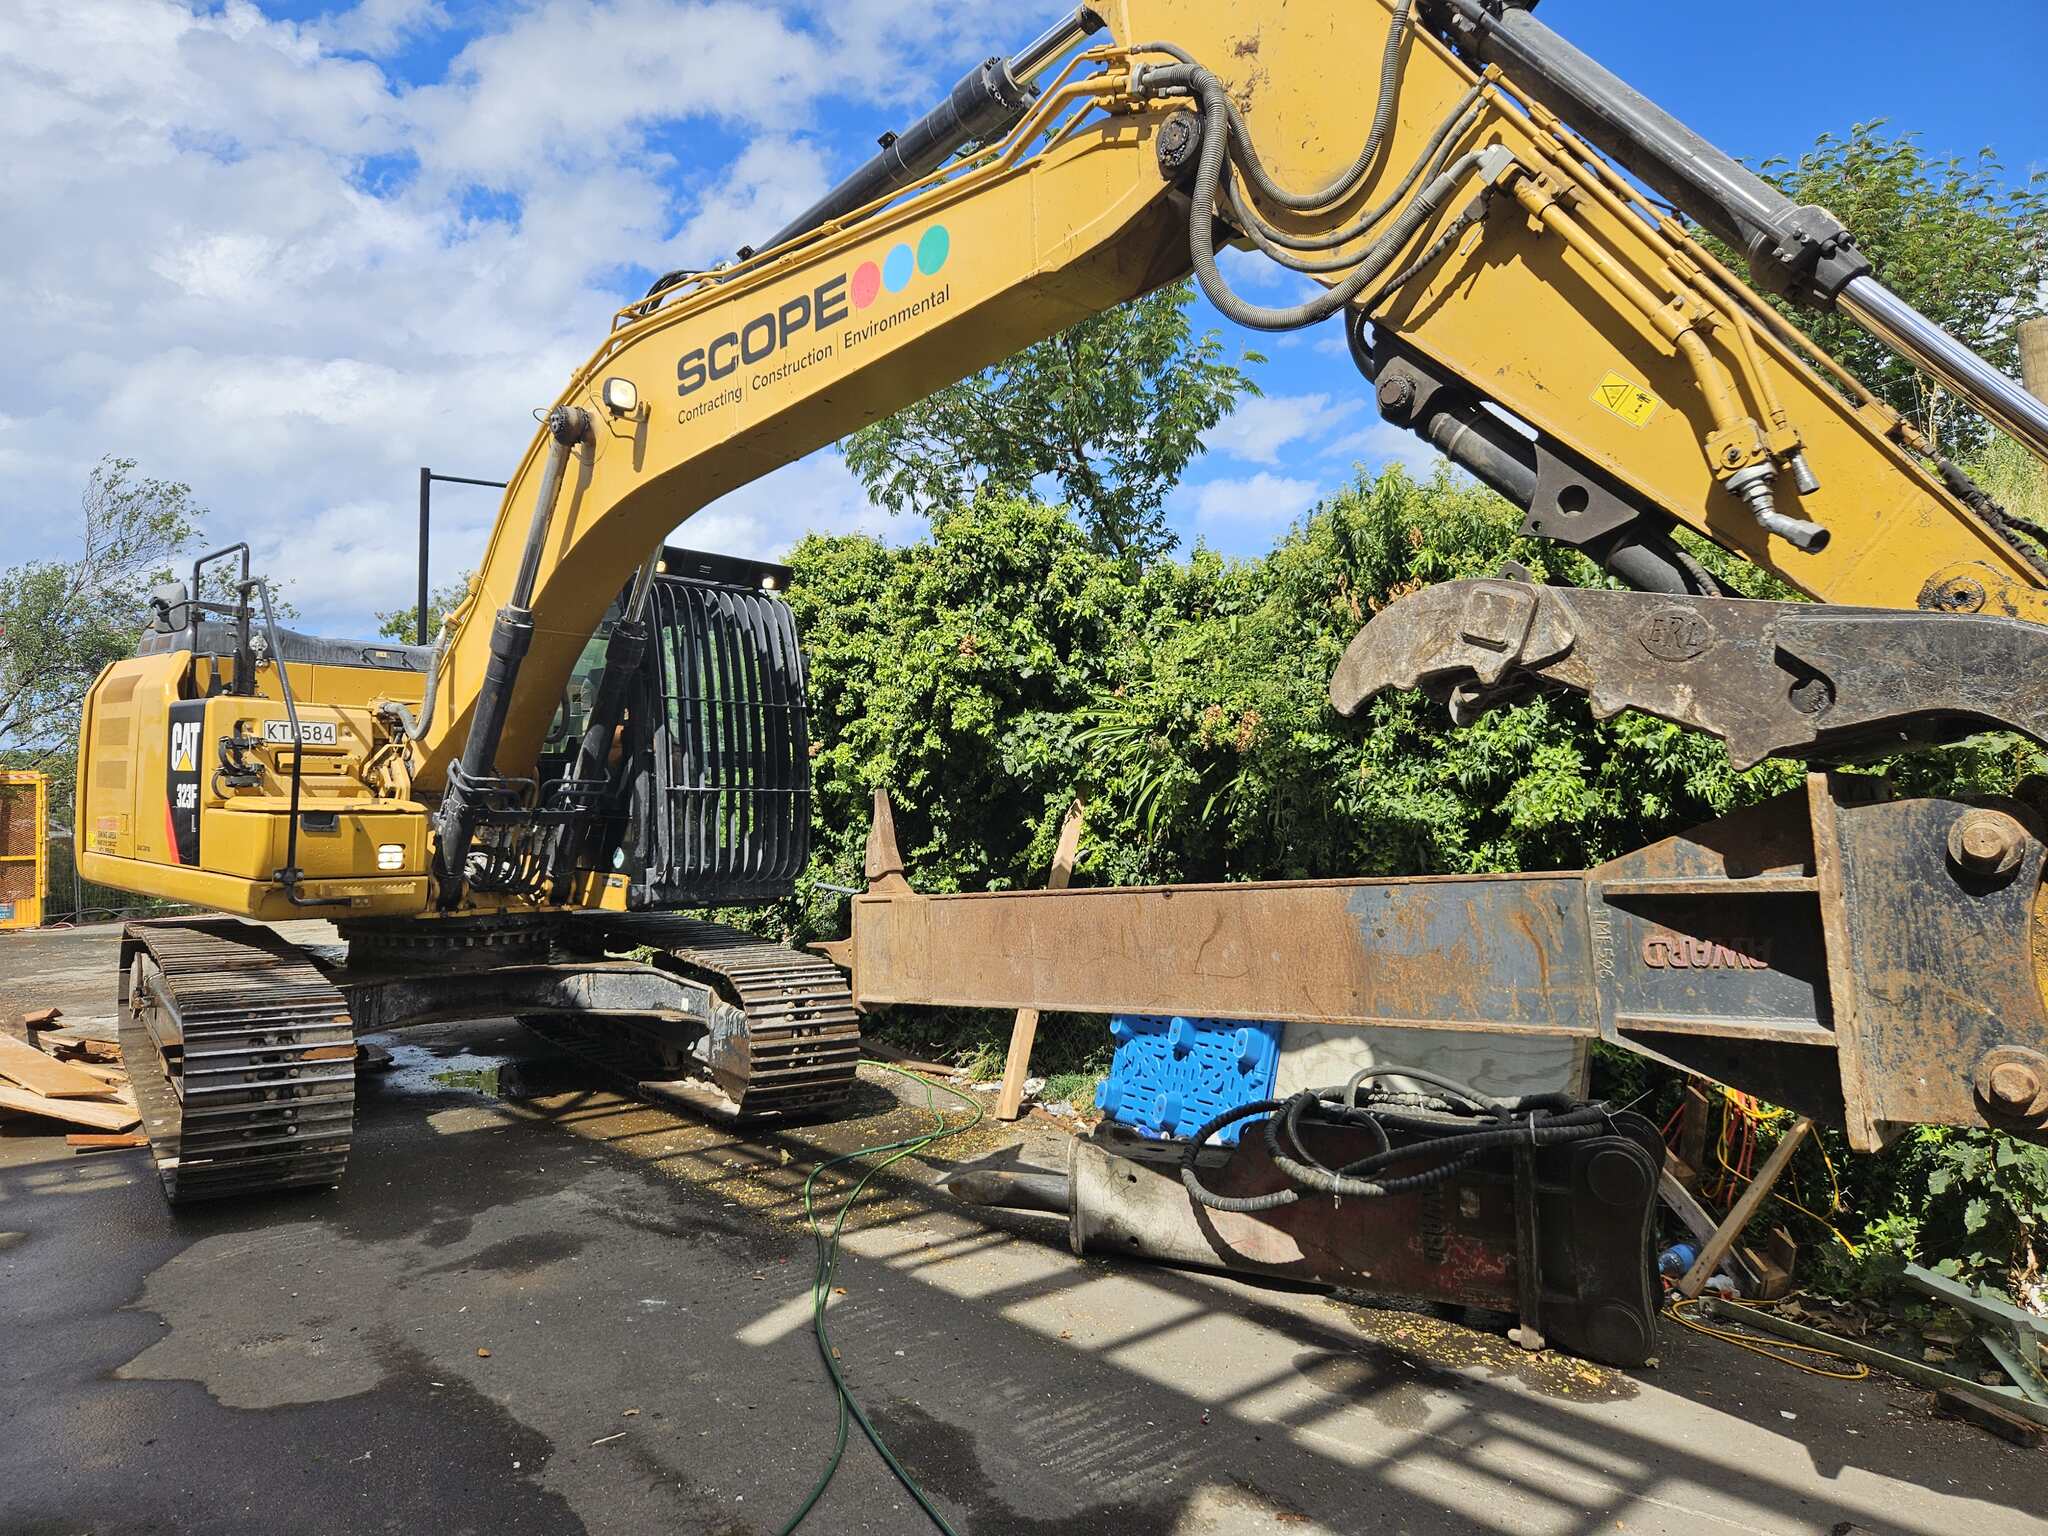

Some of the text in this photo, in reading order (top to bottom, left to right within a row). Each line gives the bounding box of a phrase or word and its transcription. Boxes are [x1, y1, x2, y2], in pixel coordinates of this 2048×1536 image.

[677, 272, 849, 397] SCOPE
[677, 284, 950, 425] Contracting Construction Environmental
[171, 722, 201, 771] CAT
[176, 783, 198, 809] 323F
